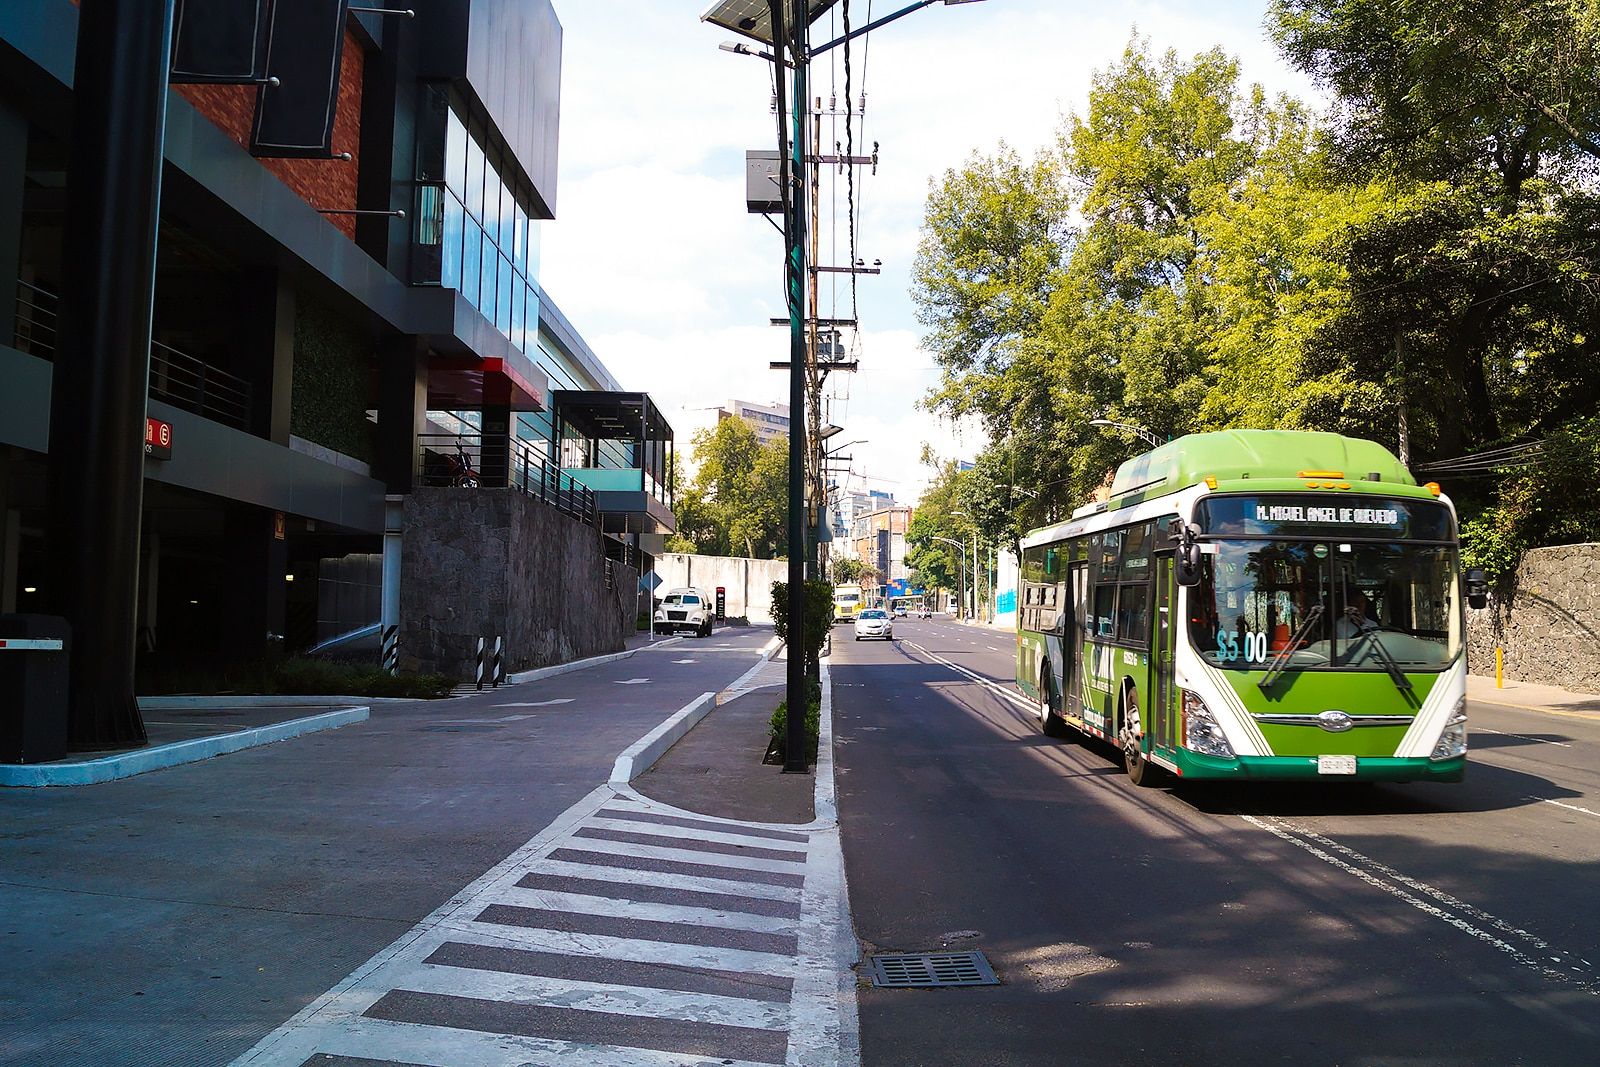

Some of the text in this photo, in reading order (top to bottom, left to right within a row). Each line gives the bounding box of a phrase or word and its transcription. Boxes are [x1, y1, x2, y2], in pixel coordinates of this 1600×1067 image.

[1270, 506, 1306, 521] MIGUEL
[1307, 507, 1339, 522] ANGEL
[1340, 508, 1353, 523] DE
[1354, 509, 1398, 524] QUEVEDO
